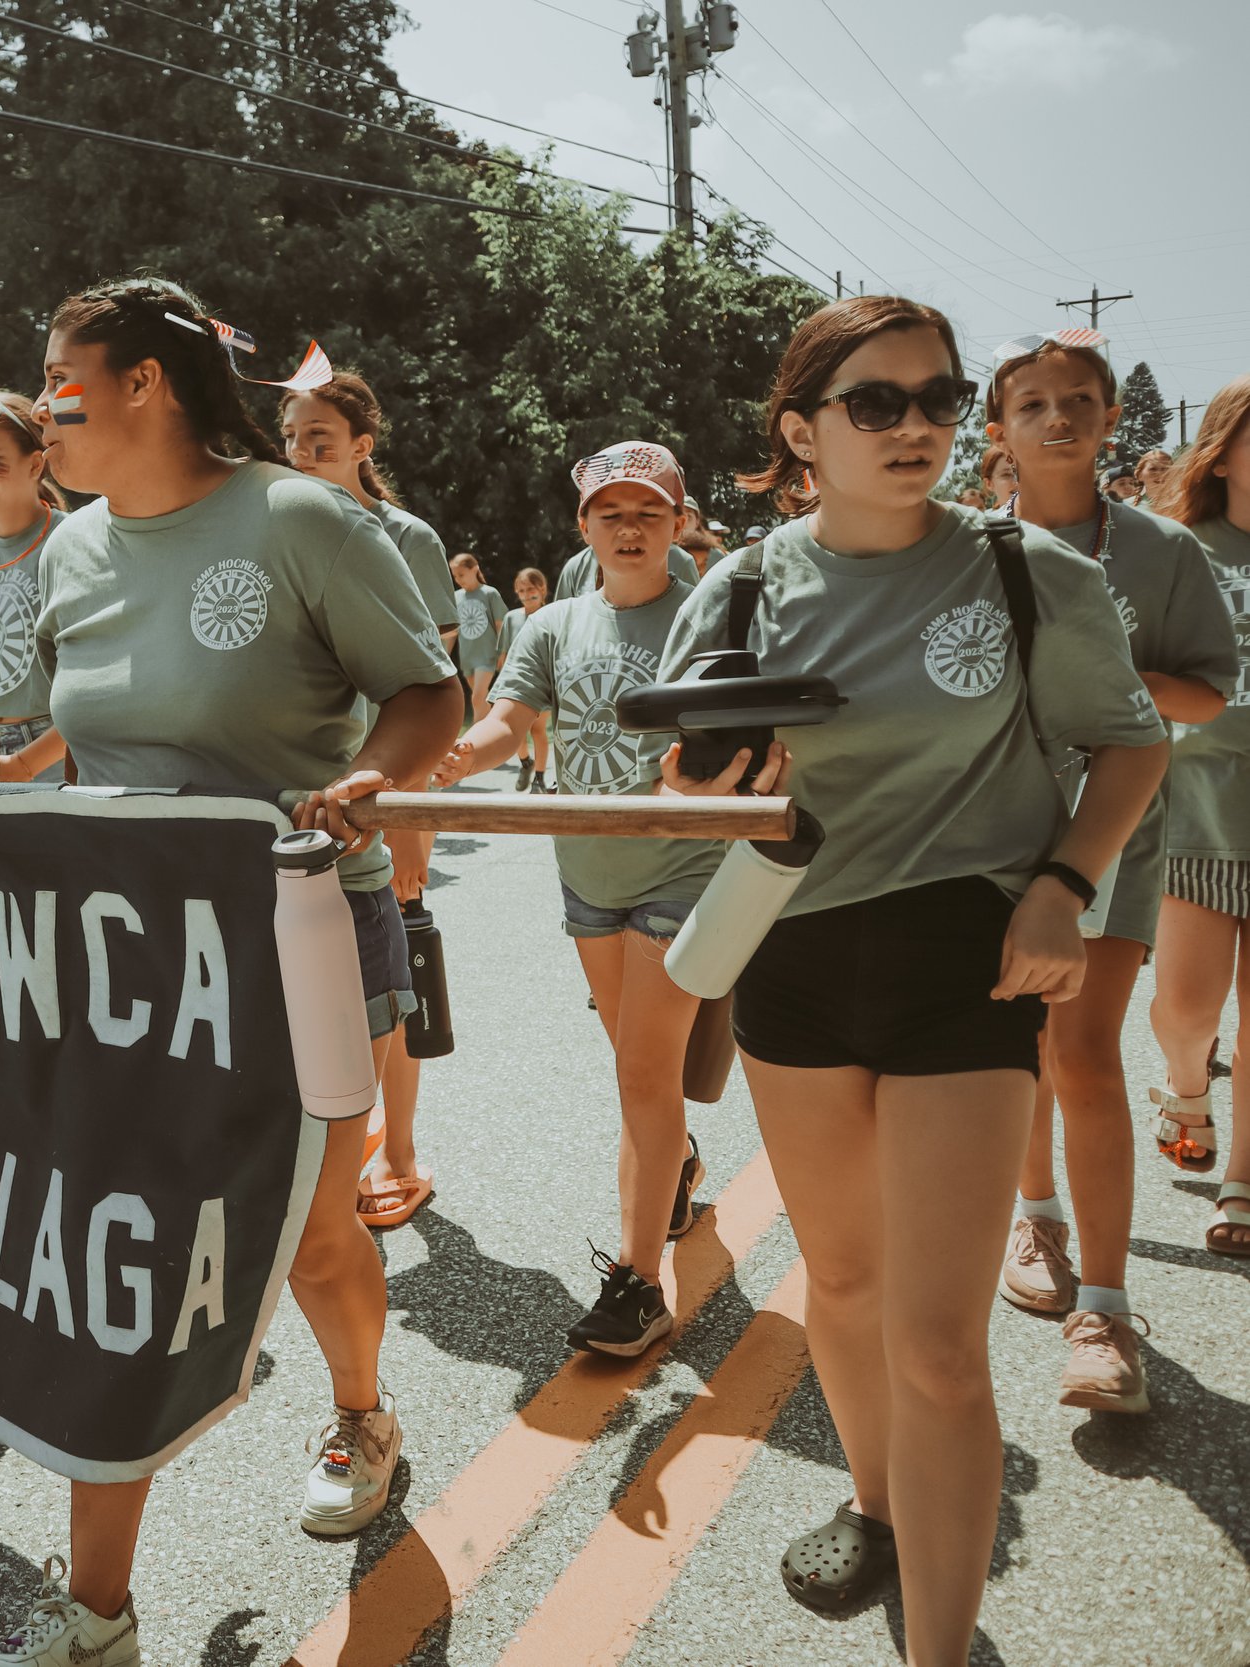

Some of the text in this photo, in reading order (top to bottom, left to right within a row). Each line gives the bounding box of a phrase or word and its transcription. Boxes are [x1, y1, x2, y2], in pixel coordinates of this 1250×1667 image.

[191, 558, 274, 593] CAMP HOCHELAGA
[216, 605, 239, 614] 2023
[920, 612, 949, 641] CAMP
[958, 646, 985, 658] 2023
[582, 720, 616, 736] 023
